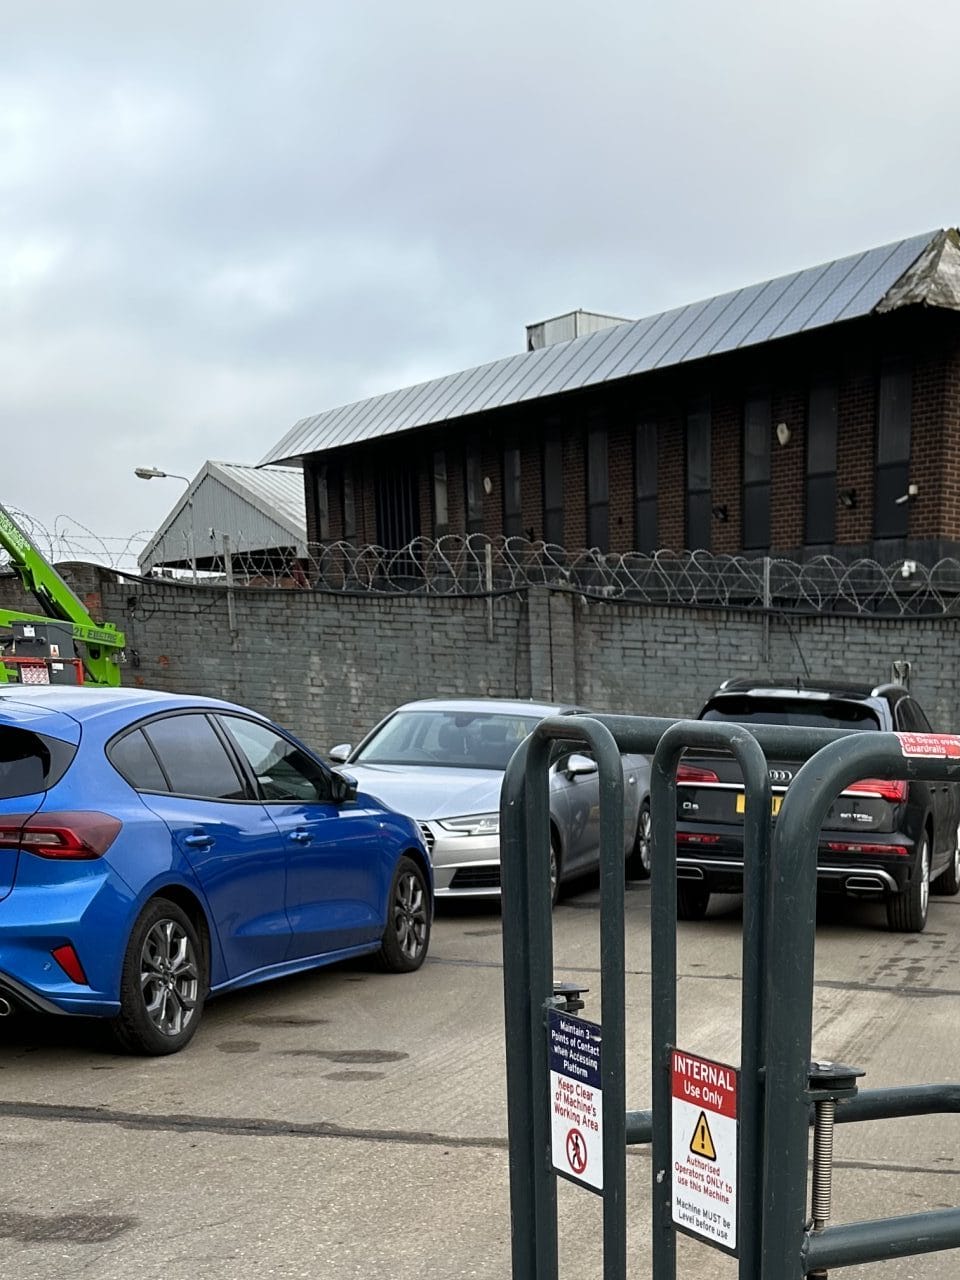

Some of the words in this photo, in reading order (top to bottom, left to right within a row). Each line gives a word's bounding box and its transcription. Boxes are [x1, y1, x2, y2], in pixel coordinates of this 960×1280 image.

[905, 744, 947, 754] Guardrails
[551, 1029, 569, 1045] Points
[570, 1037, 576, 1047] of
[577, 1040, 600, 1056] Contact
[560, 1020, 585, 1038] Maintain
[585, 1029, 590, 1040] 3
[553, 1045, 568, 1058] when
[569, 1049, 598, 1071] Accessing
[563, 1059, 588, 1078] Platform
[674, 1054, 735, 1092] INTERNAL
[557, 1076, 574, 1095] Keep
[576, 1084, 594, 1102] Clear
[683, 1079, 700, 1099] Use
[702, 1086, 723, 1110] Only
[554, 1102, 580, 1126] Working
[582, 1115, 599, 1131] Area
[555, 1090, 562, 1102] of
[563, 1092, 597, 1117] Machine's
[674, 1161, 704, 1182] Operators
[706, 1174, 724, 1189] ONLY
[725, 1183, 733, 1194] to
[686, 1155, 720, 1177] Authorised
[677, 1176, 688, 1187] use
[689, 1180, 702, 1193] this
[703, 1185, 730, 1205] Machine
[676, 1196, 701, 1215] Machine
[702, 1208, 721, 1224] MUST
[722, 1217, 731, 1229] be
[678, 1209, 694, 1224] Level
[696, 1218, 715, 1234] before
[716, 1229, 729, 1240] use
